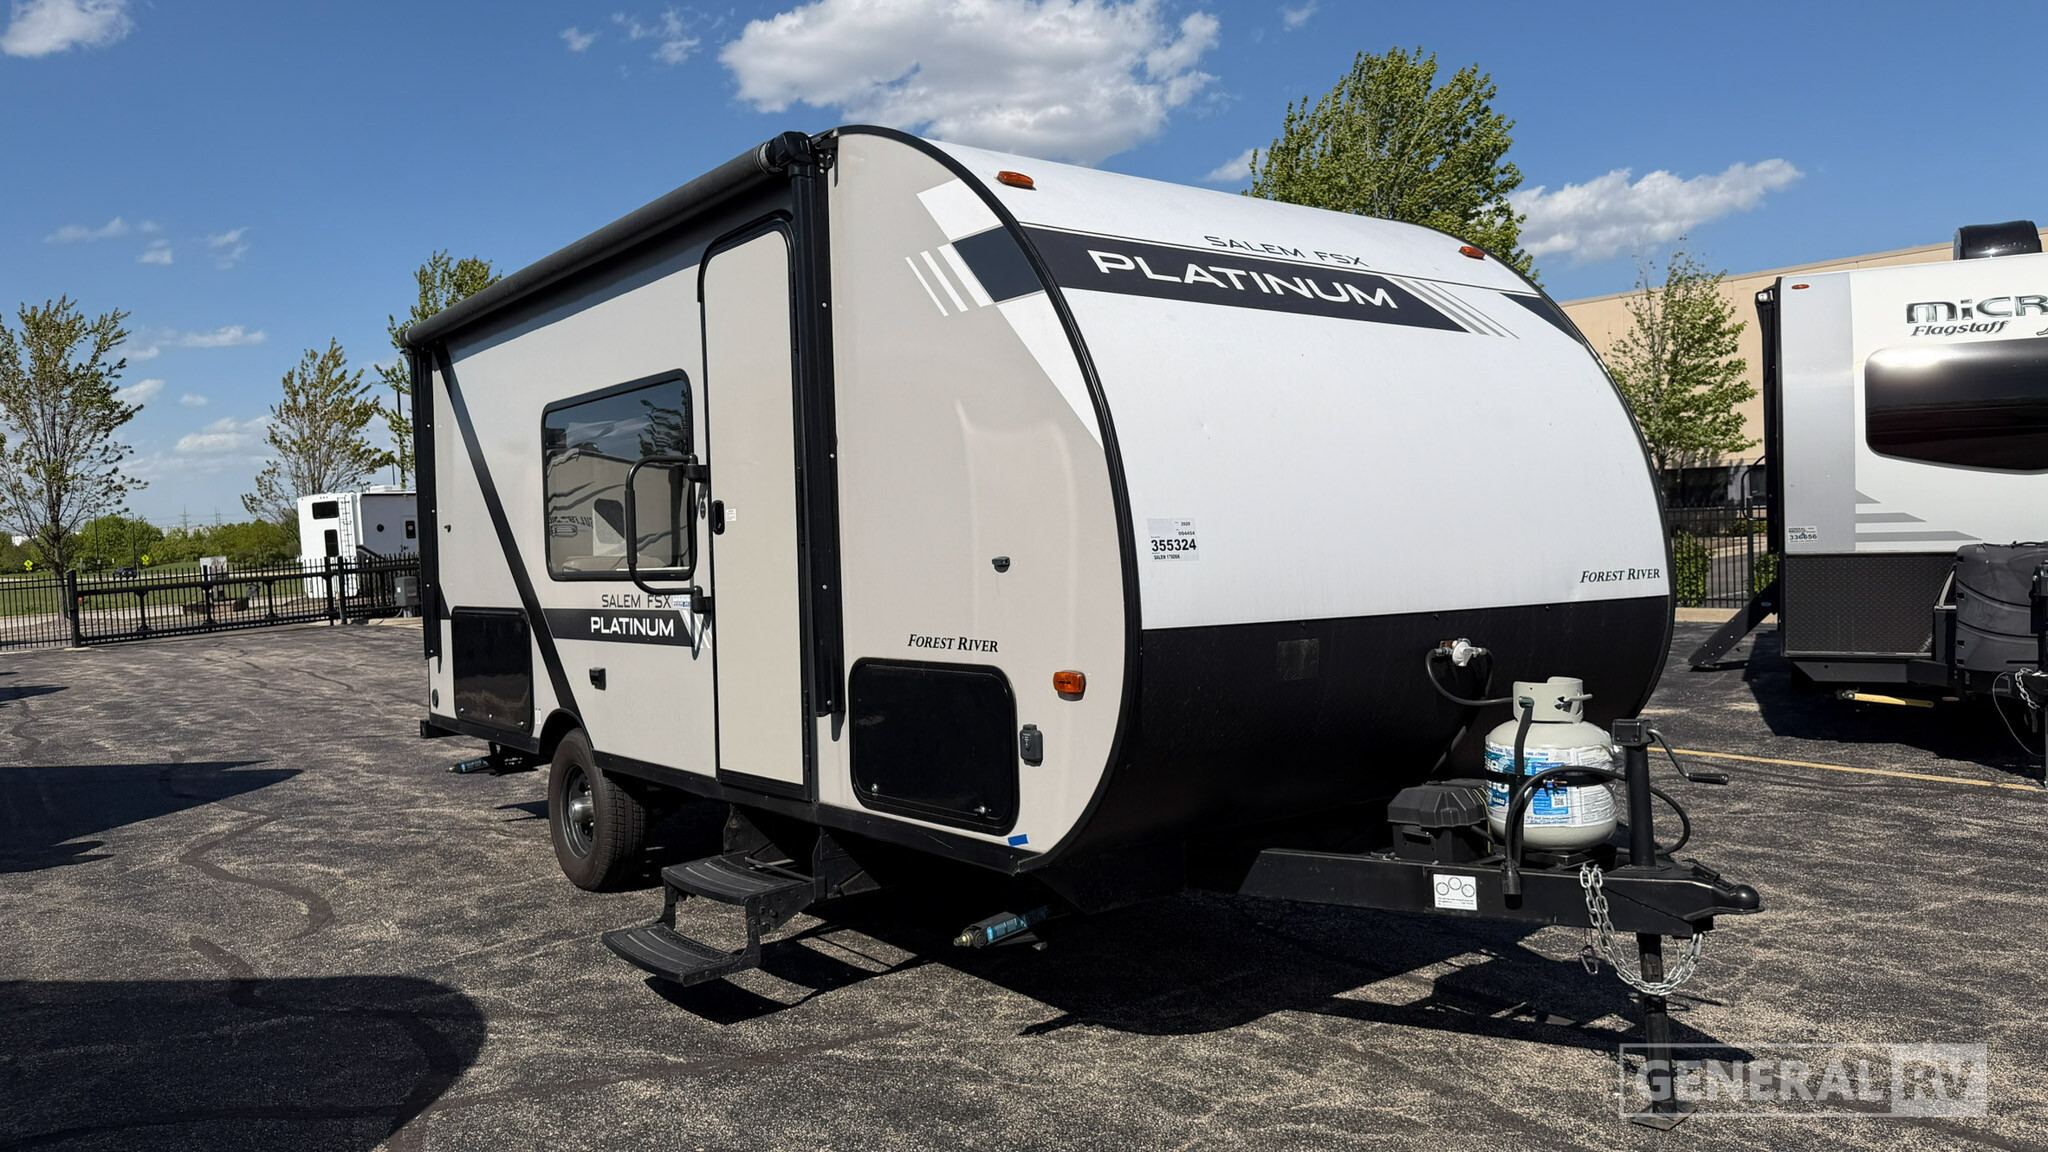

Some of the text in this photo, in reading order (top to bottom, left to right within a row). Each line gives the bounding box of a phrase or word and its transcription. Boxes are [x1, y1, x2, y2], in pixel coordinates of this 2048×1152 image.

[1204, 235, 1370, 267] SALEM FSX
[1087, 250, 1398, 309] PLATINUM
[1911, 320, 2009, 336] Flagstaff
[1151, 538, 1197, 552] 355324
[1580, 567, 1661, 583] FOREST RIVER
[601, 594, 641, 608] SALEM
[648, 594, 672, 609] FSX
[590, 616, 675, 638] PLATINUM
[908, 633, 999, 653] FOREST RIVER
